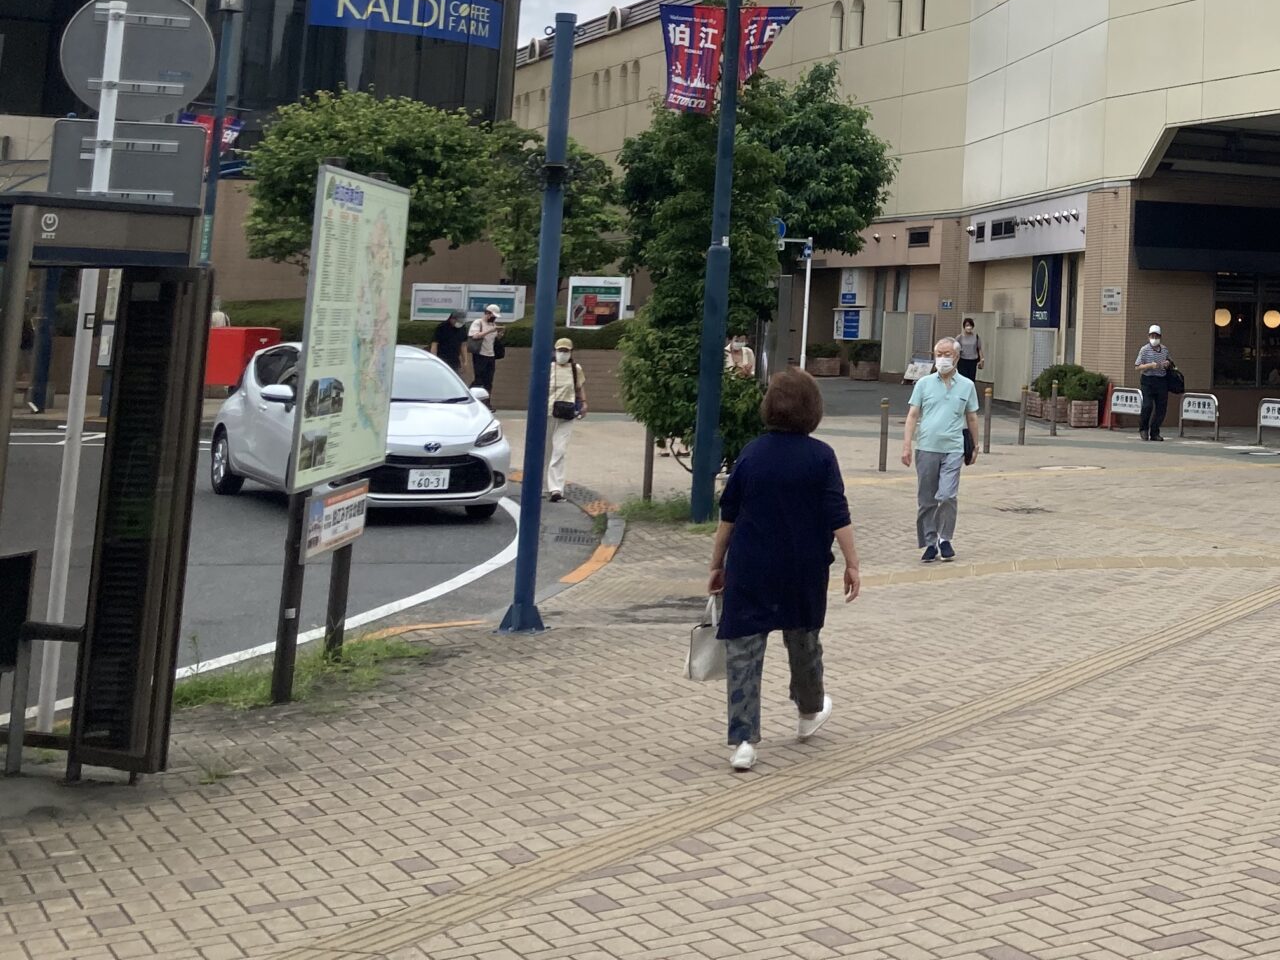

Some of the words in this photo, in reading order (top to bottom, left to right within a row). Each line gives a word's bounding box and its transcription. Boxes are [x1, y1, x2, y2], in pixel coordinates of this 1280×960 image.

[449, 18, 490, 38] FARM
[667, 23, 718, 49] 狛江
[417, 477, 445, 488] 60-31
